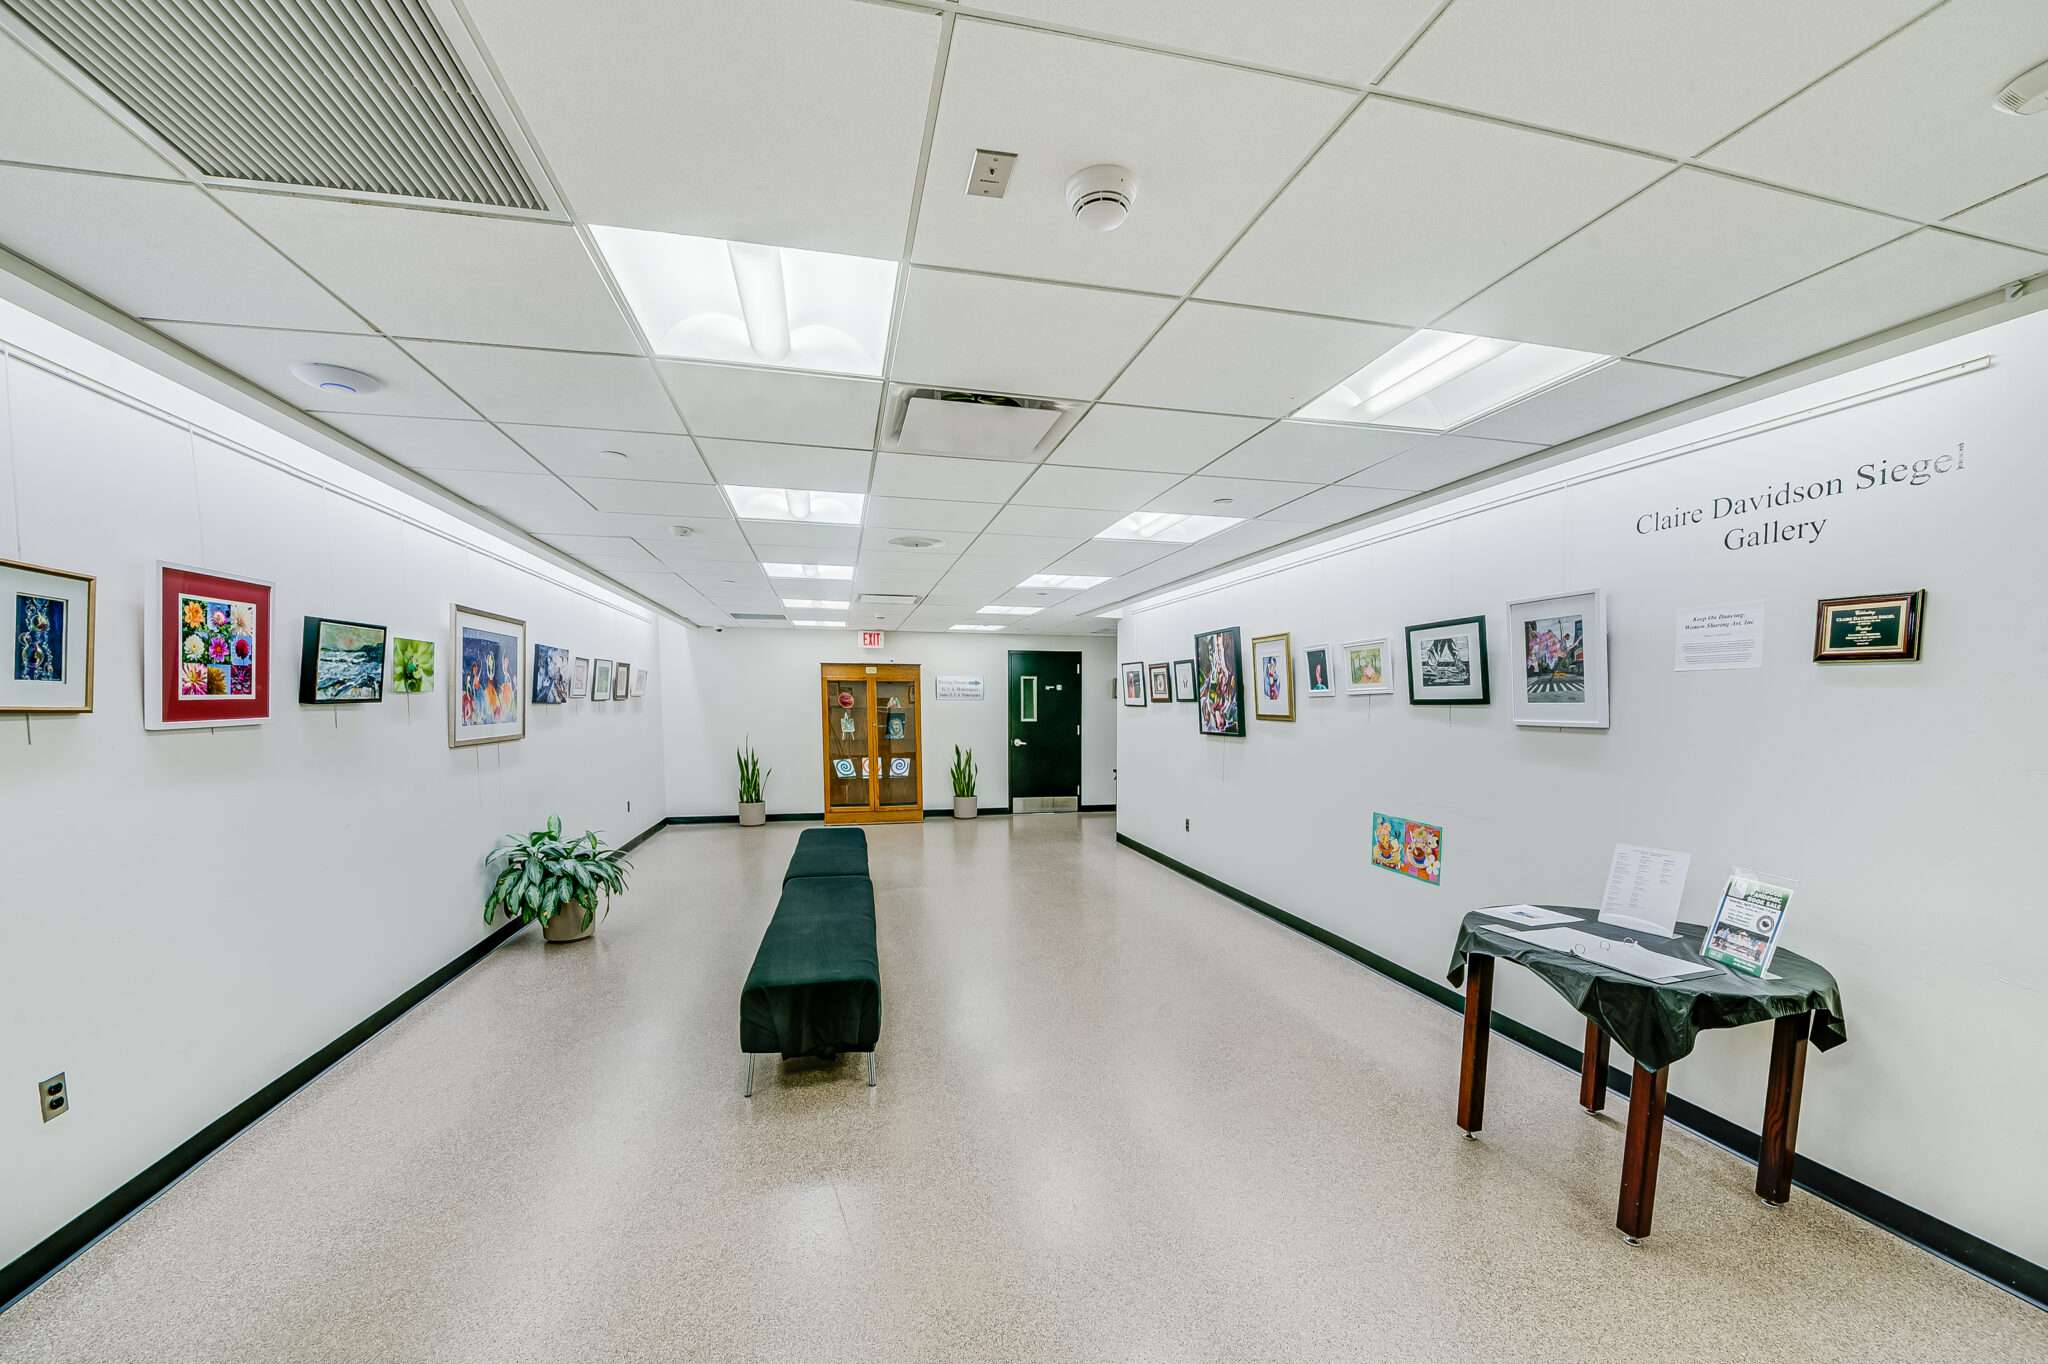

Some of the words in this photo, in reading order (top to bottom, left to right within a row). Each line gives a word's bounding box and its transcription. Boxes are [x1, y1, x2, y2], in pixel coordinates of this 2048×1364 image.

[1636, 507, 1704, 535] Claire
[1712, 478, 1844, 519] Davidson
[1856, 442, 1966, 490] Siegel
[1724, 518, 1828, 551] Gallery
[863, 632, 881, 646] EXIT
[1747, 896, 1765, 905] BOOK
[1765, 901, 1782, 910] SALE
